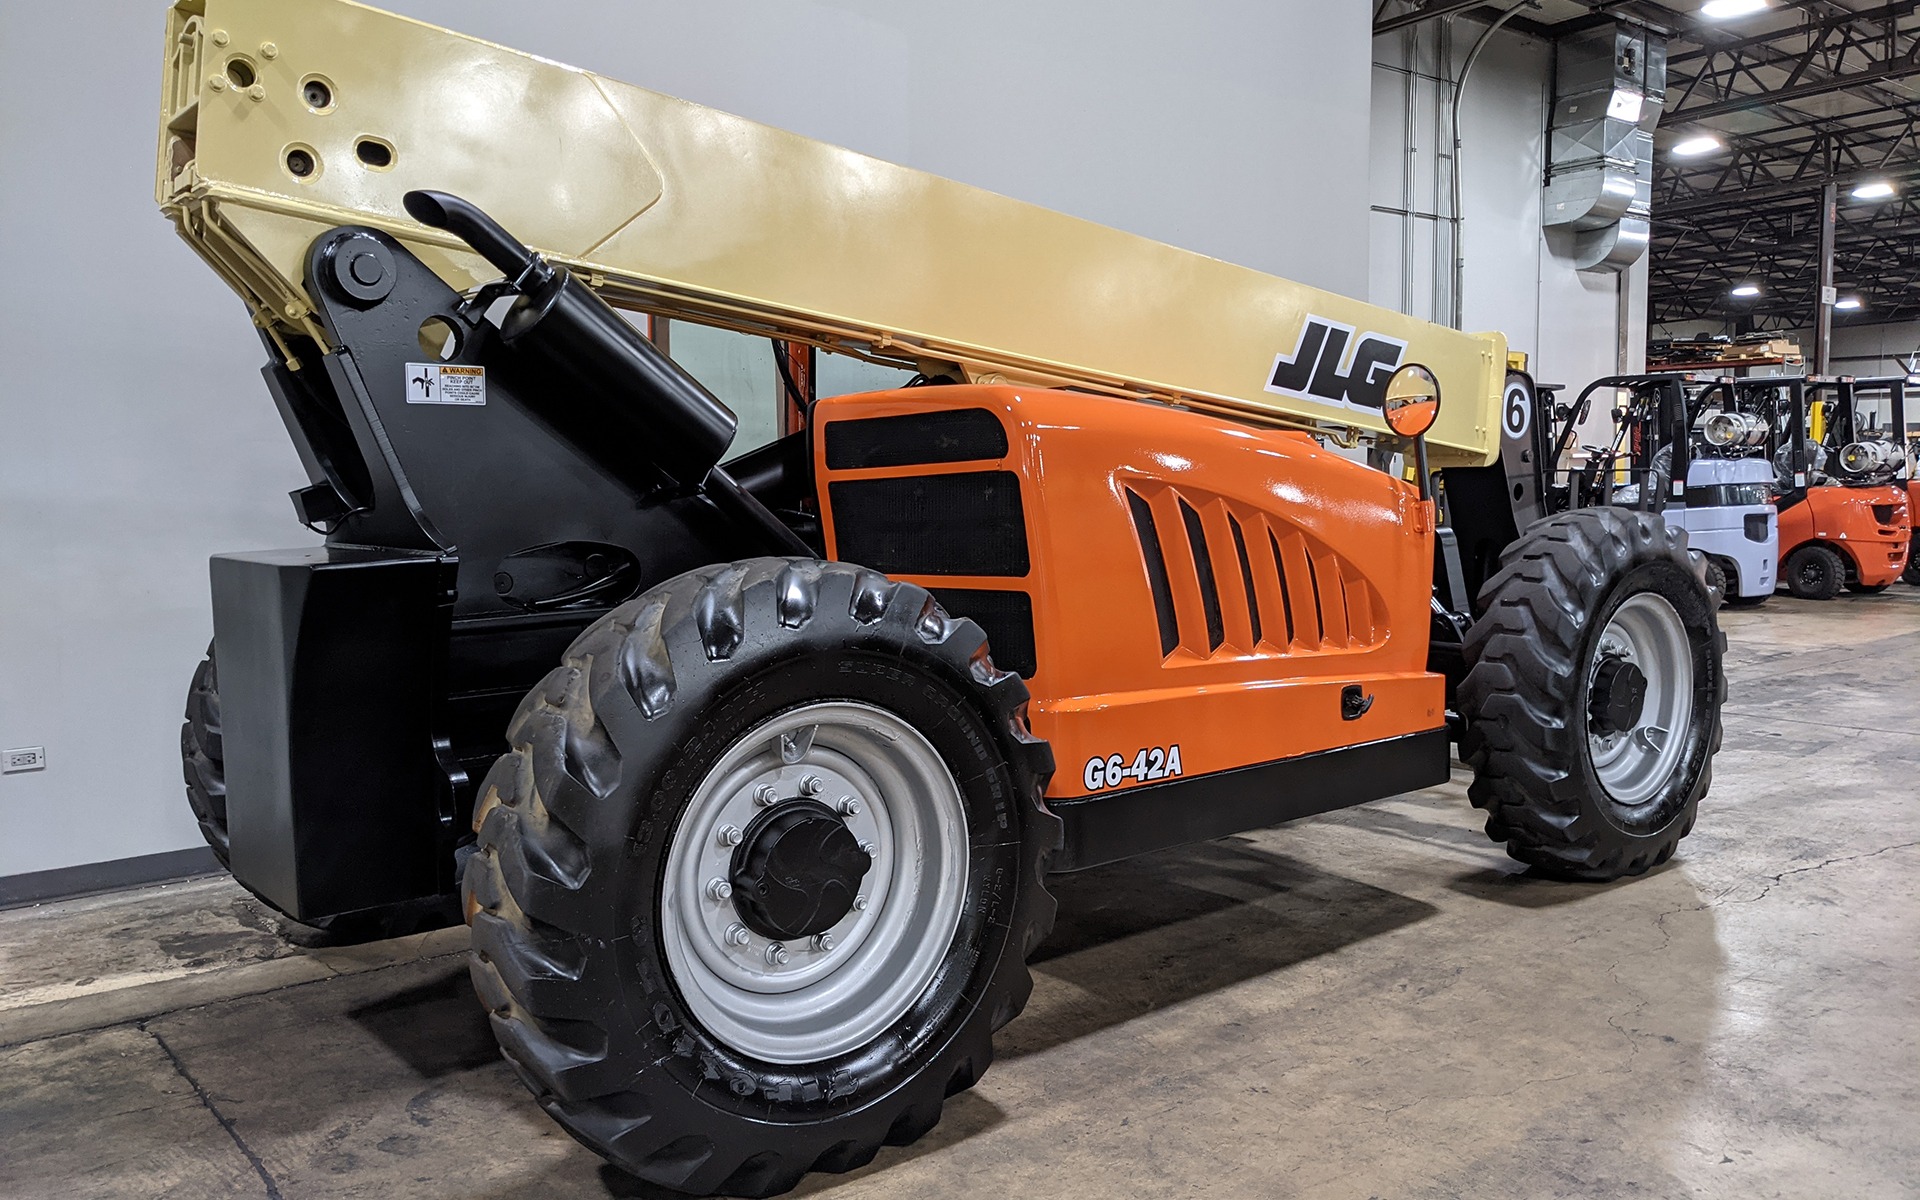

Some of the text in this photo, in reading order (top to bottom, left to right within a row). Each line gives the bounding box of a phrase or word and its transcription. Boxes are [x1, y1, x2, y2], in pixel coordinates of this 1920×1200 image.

[450, 367, 482, 375] WARNING
[1270, 320, 1404, 409] JLG
[1505, 388, 1526, 434] 6
[1084, 744, 1183, 791] G6-42A
